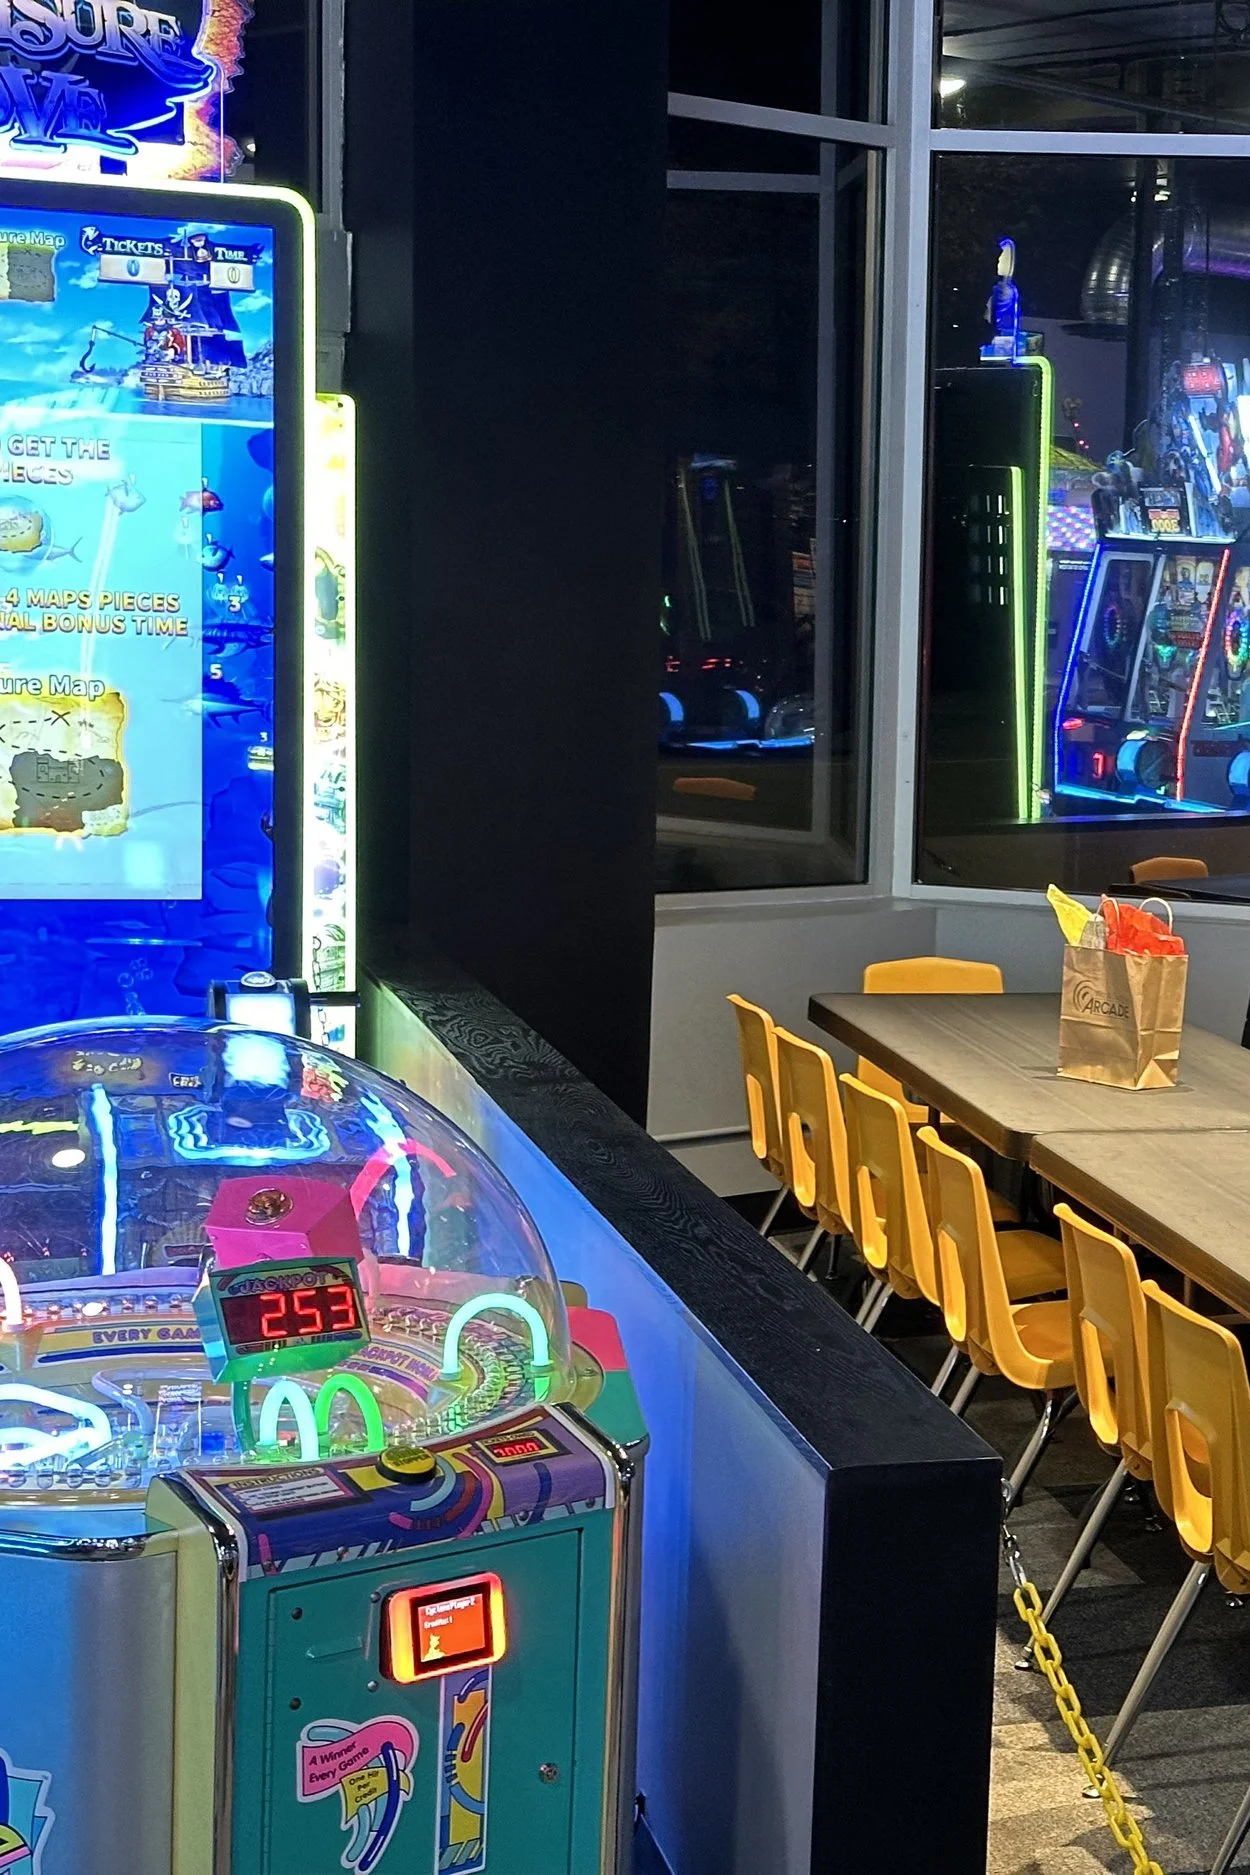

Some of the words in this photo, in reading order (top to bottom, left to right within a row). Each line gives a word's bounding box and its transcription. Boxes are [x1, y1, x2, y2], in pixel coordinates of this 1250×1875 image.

[0, 0, 180, 62] SURE
[30, 231, 66, 248] Map
[102, 237, 164, 256] TICKETS
[127, 259, 140, 277] 0
[227, 266, 241, 284] 0
[7, 433, 56, 458] GET
[61, 436, 110, 460] THE
[6, 587, 20, 607] 4
[26, 588, 92, 610] MAPS
[99, 591, 181, 613] PIECES
[228, 595, 241, 613] 3
[42, 613, 126, 635] BONUS
[132, 615, 189, 637] TIME
[209, 663, 223, 680] 5
[49, 675, 106, 701] Map
[1081, 997, 1130, 1019] ARCADE
[239, 1271, 328, 1294] JACKPOT
[259, 1285, 356, 1338] 253
[92, 1328, 152, 1344] EVERY
[157, 1327, 201, 1340] GAM
[360, 1345, 411, 1367] ACKPOT
[232, 1467, 322, 1489] INSTRUCTIONS
[309, 1755, 318, 1766] A
[319, 1741, 357, 1765] Winner
[309, 1768, 337, 1784] Every
[339, 1746, 370, 1772] Game
[348, 1773, 366, 1786] One
[367, 1770, 379, 1779] Hit
[356, 1781, 370, 1792] Per
[355, 1787, 378, 1804] Credit
